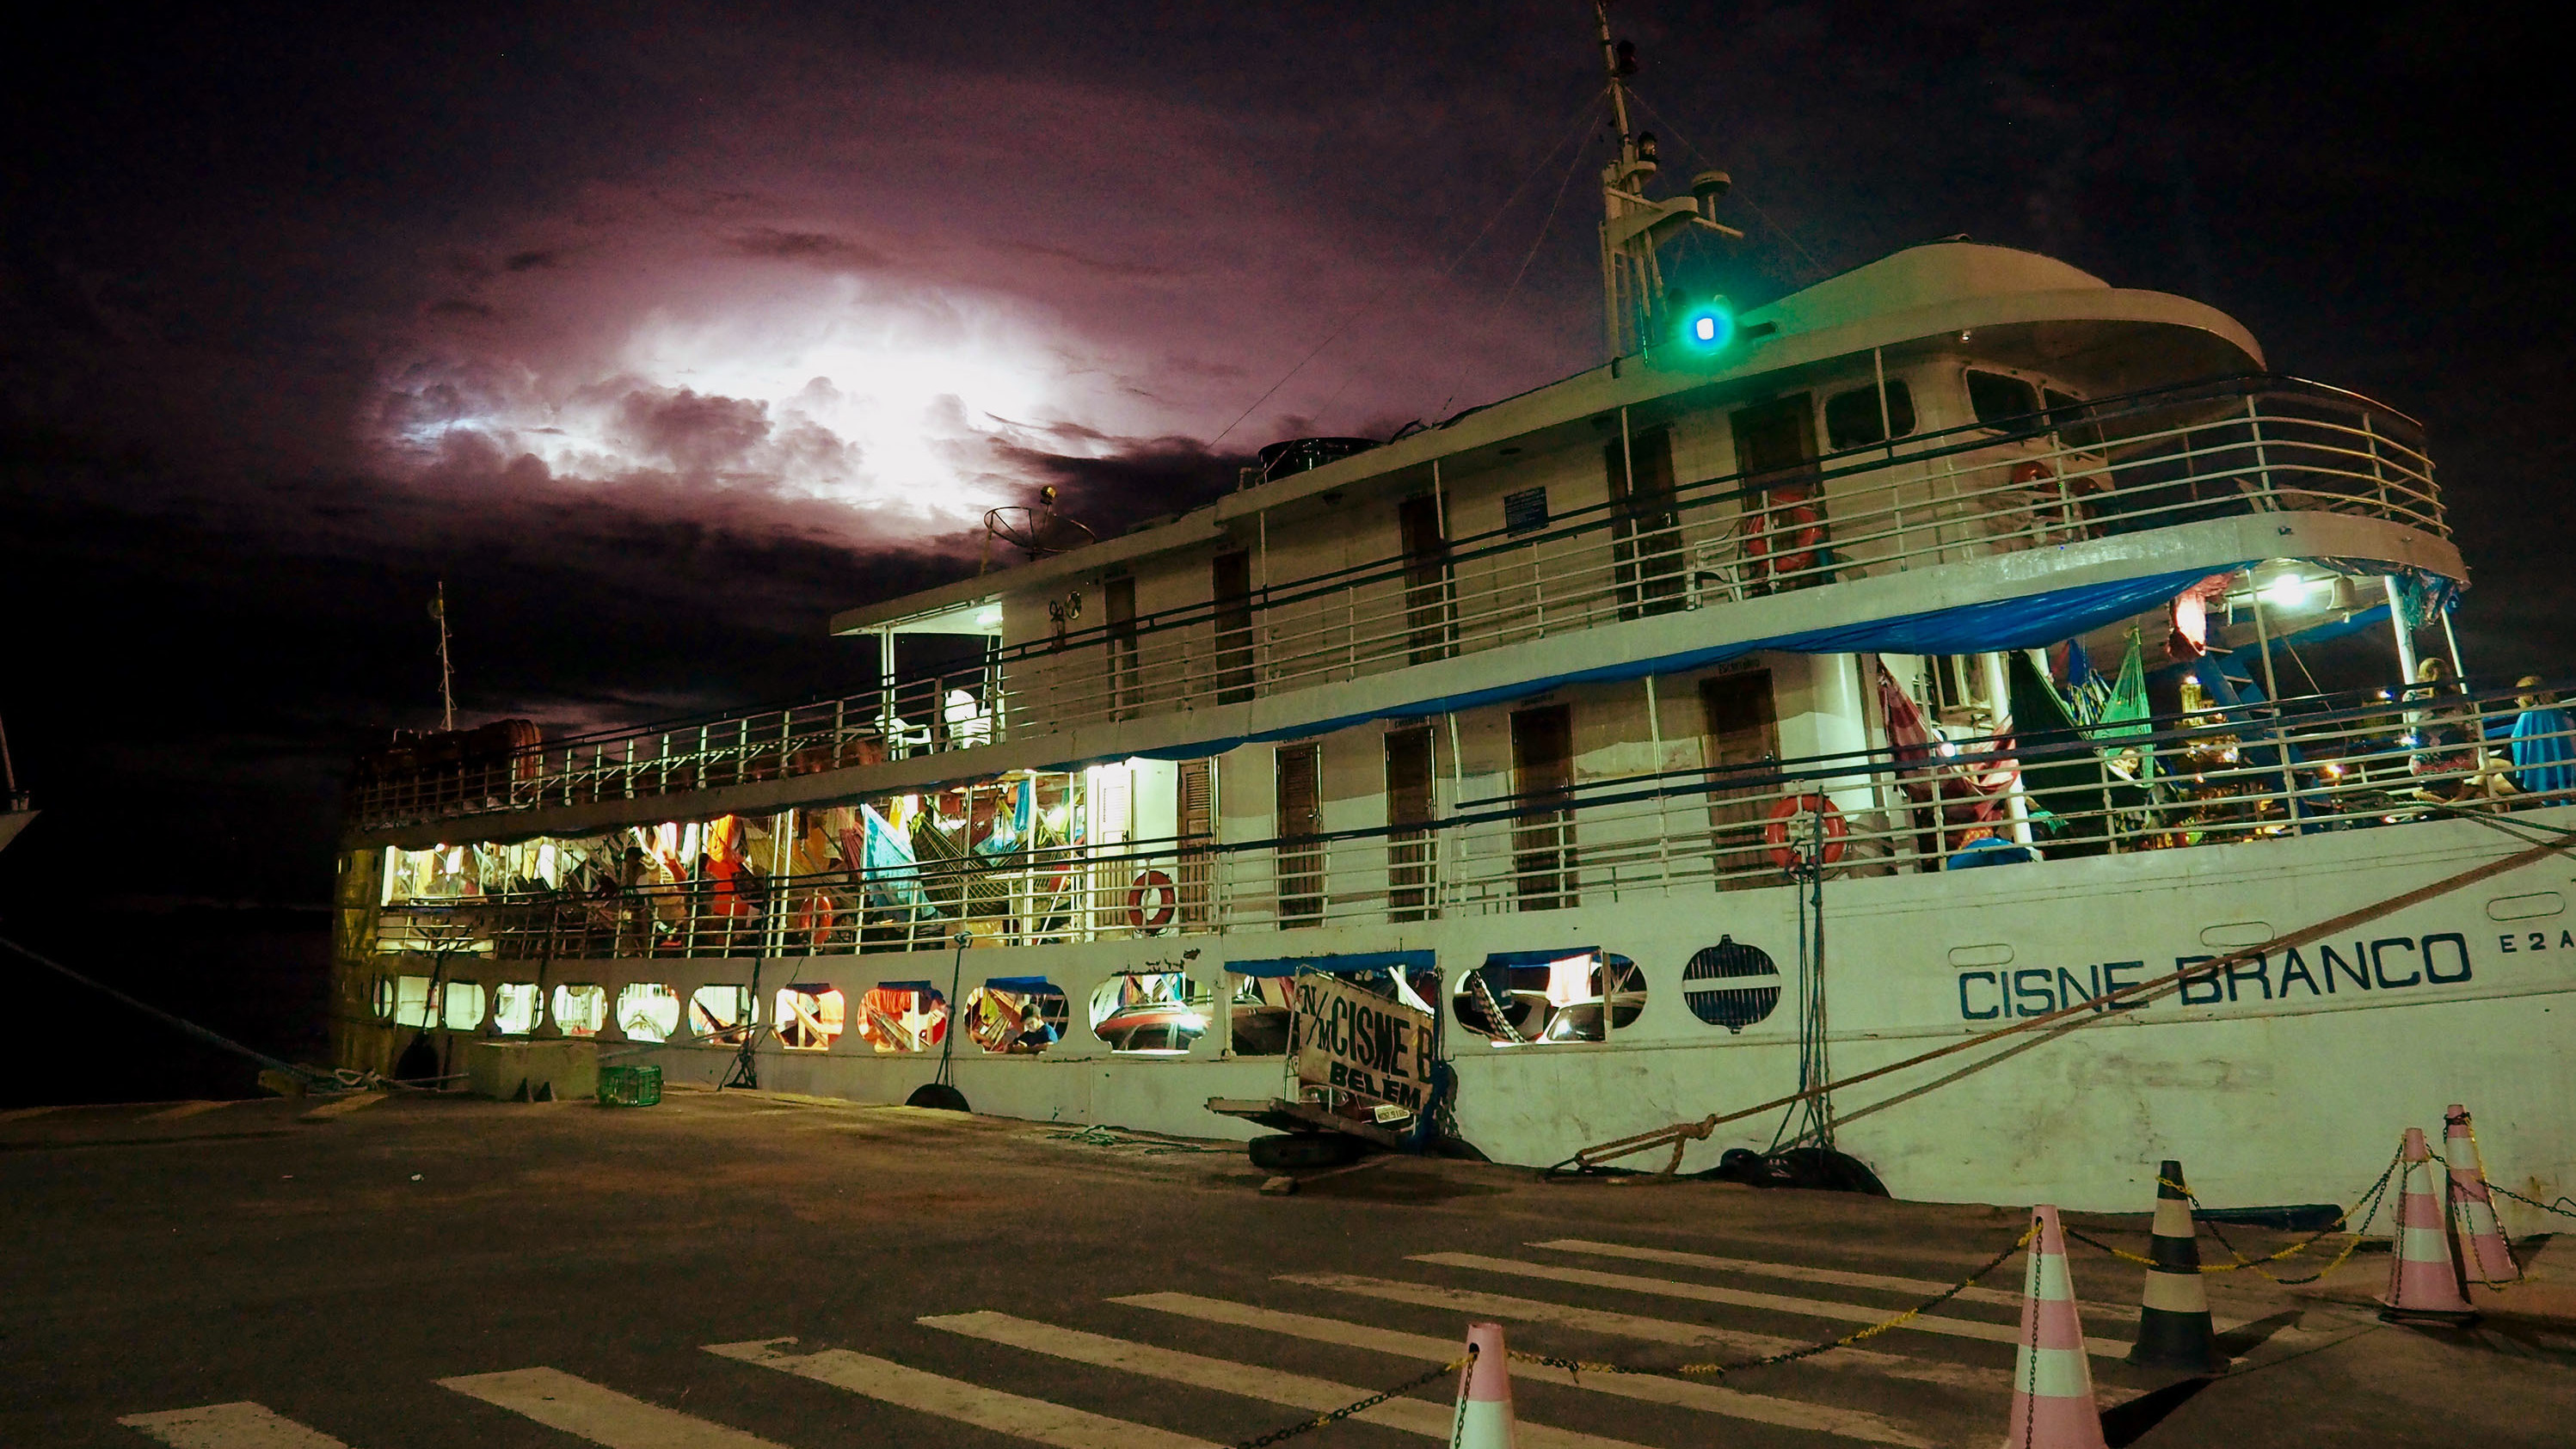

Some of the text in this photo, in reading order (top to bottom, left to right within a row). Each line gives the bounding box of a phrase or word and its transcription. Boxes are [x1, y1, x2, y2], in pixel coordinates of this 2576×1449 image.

[1958, 961, 2149, 1021] CISNE
[2175, 931, 2473, 1006] BRANCO
[1331, 996, 1411, 1078] CISNE
